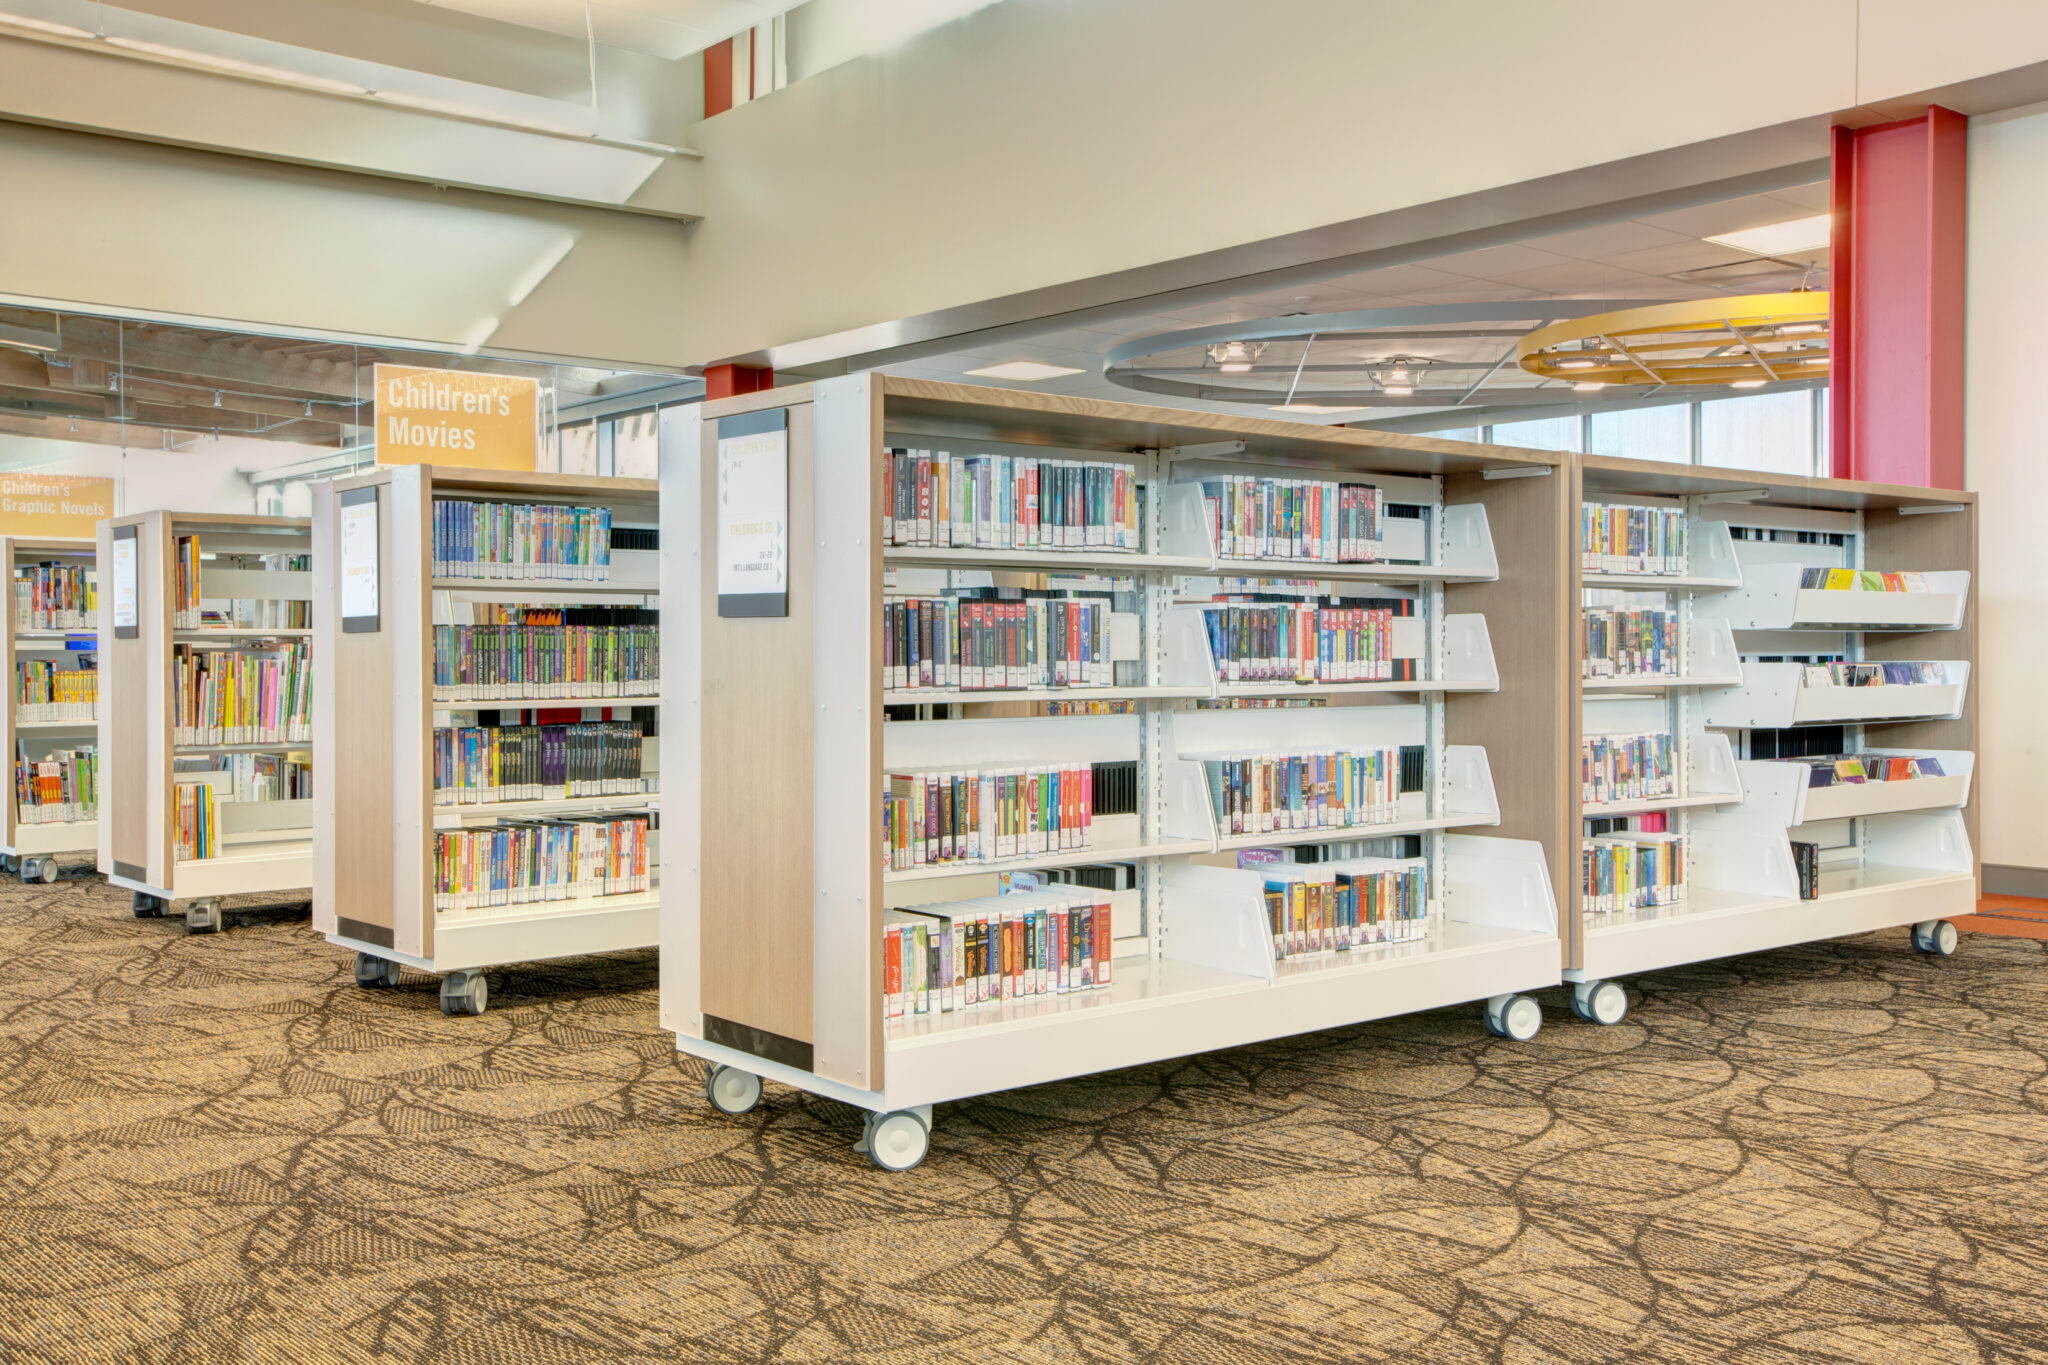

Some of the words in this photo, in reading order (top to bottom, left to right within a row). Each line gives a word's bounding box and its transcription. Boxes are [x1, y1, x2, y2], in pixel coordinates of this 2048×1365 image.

[388, 378, 511, 417] Children's
[388, 415, 476, 450] Movies
[2, 479, 71, 497] Children's
[2, 498, 56, 515] Graphic
[61, 500, 105, 517] Novels
